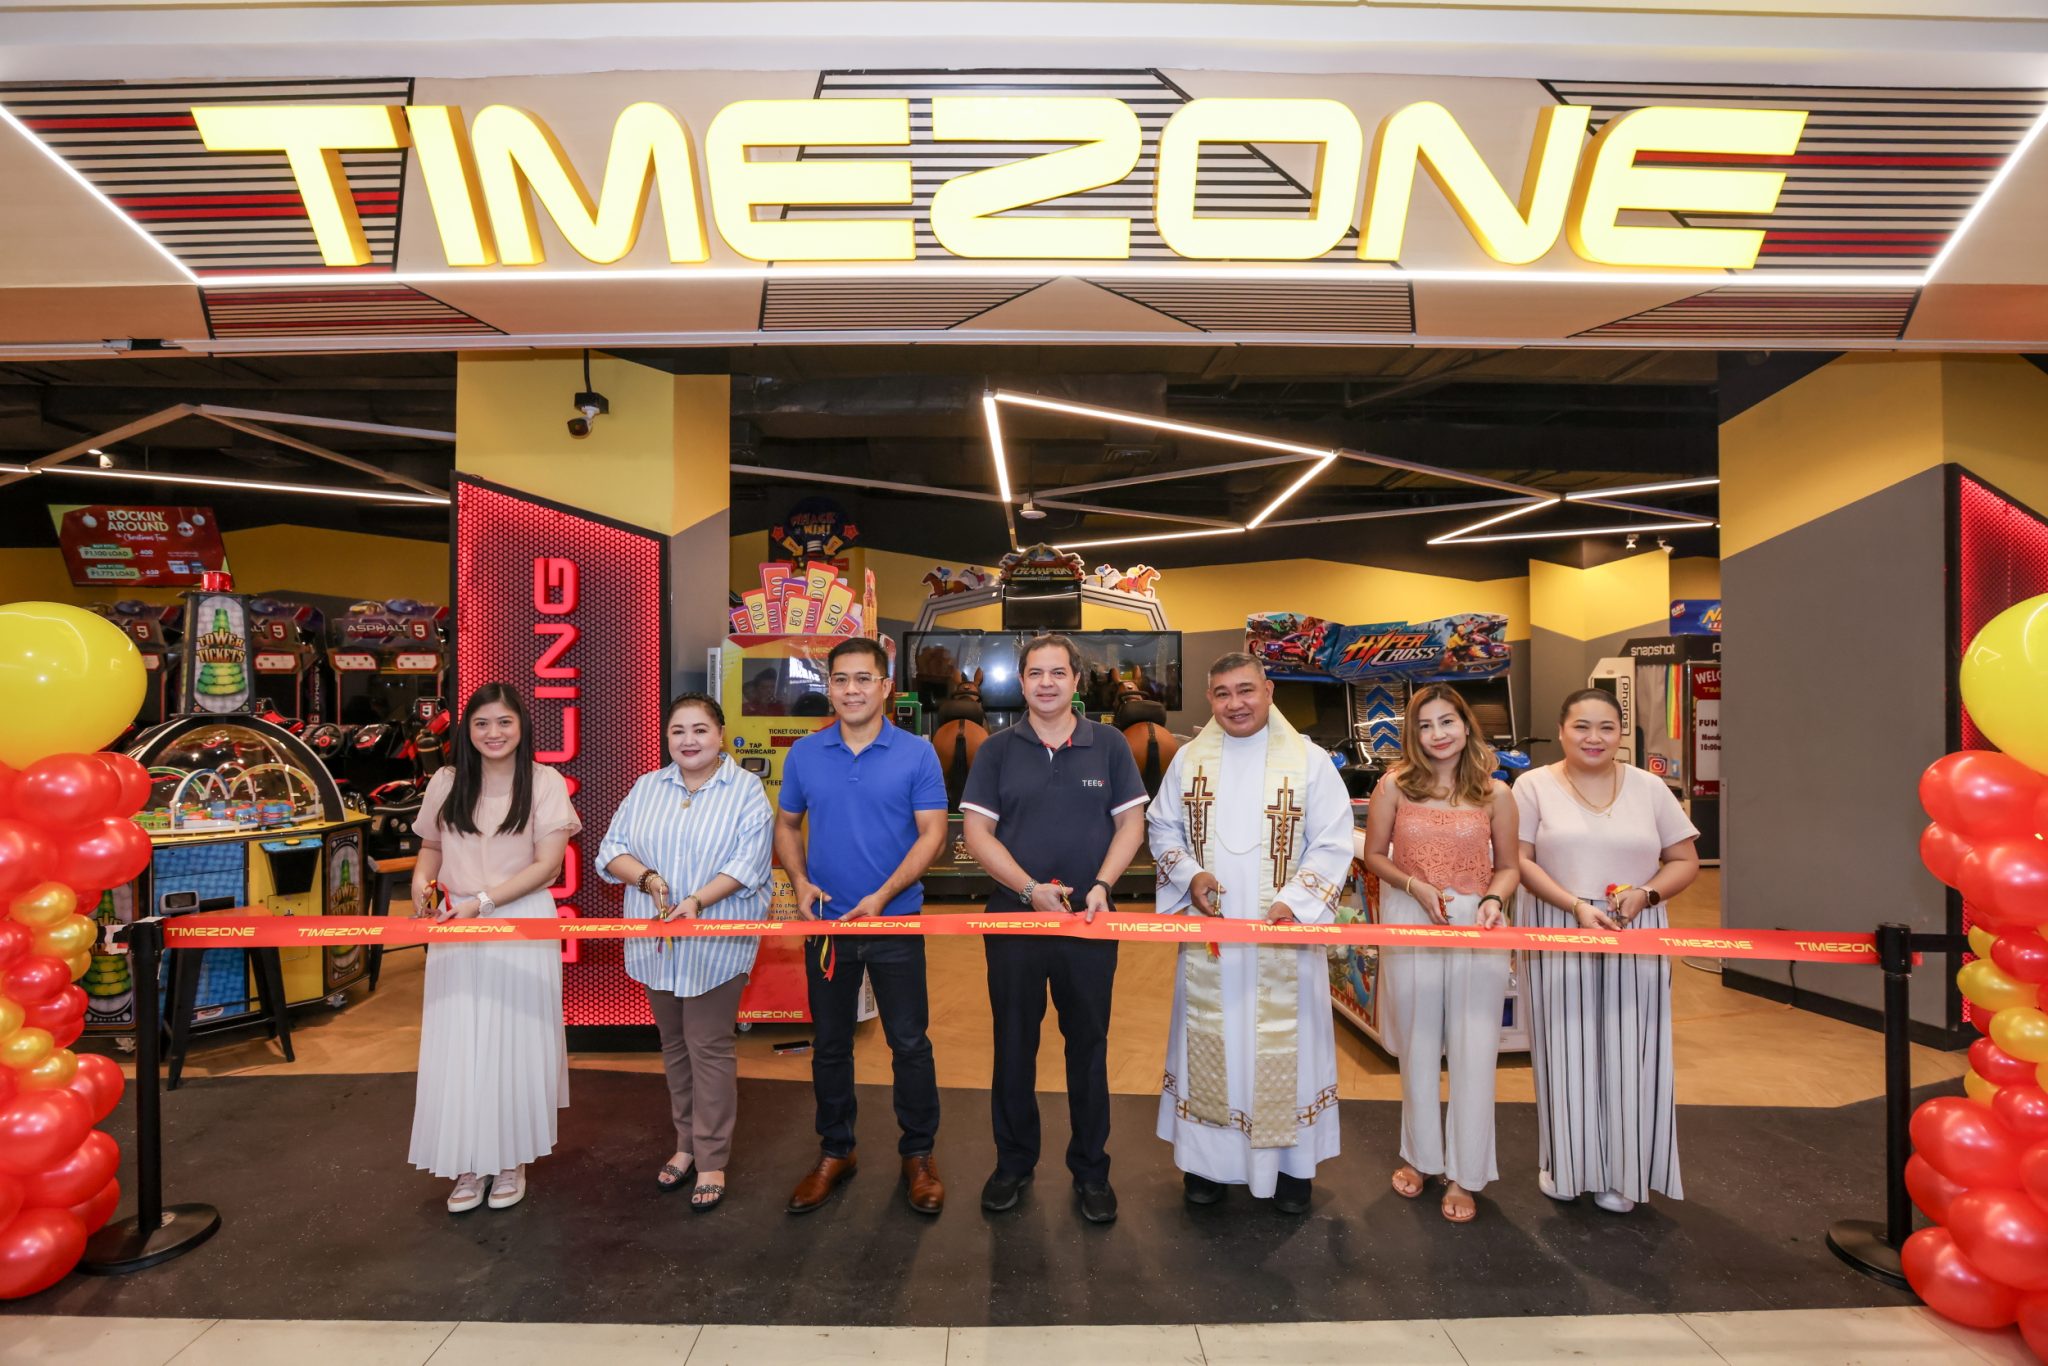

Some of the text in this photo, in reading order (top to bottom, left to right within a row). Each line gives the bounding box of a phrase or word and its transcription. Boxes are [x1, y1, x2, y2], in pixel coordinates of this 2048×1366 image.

[190, 96, 1808, 270] TIMEZONE
[107, 510, 165, 522] ROCKIN'
[107, 521, 169, 533] AROUND
[751, 602, 766, 630] 100
[788, 607, 804, 627] 50
[805, 607, 817, 629] 100
[825, 602, 843, 627] 50
[197, 627, 246, 649] TOWER
[273, 625, 284, 638] 9
[347, 624, 426, 638] ASPHALT 9
[197, 648, 246, 663] TICKETS
[1338, 629, 1430, 673] HYPER
[1370, 647, 1441, 667] CROSS
[1630, 643, 1676, 657] snapshot
[421, 704, 433, 717] 9
[1699, 719, 1718, 727] FUN
[167, 920, 1877, 953] TIMEZONE TIMEZONE TIMEZONE TIMEZONE TIMEZONE TIMEZONE TIMEZONE TIMEZONE TIMEZONE TIMEZONE TIMEZONE TIMEZONE TIMEZON
[738, 1010, 804, 1019] IMEZONE
